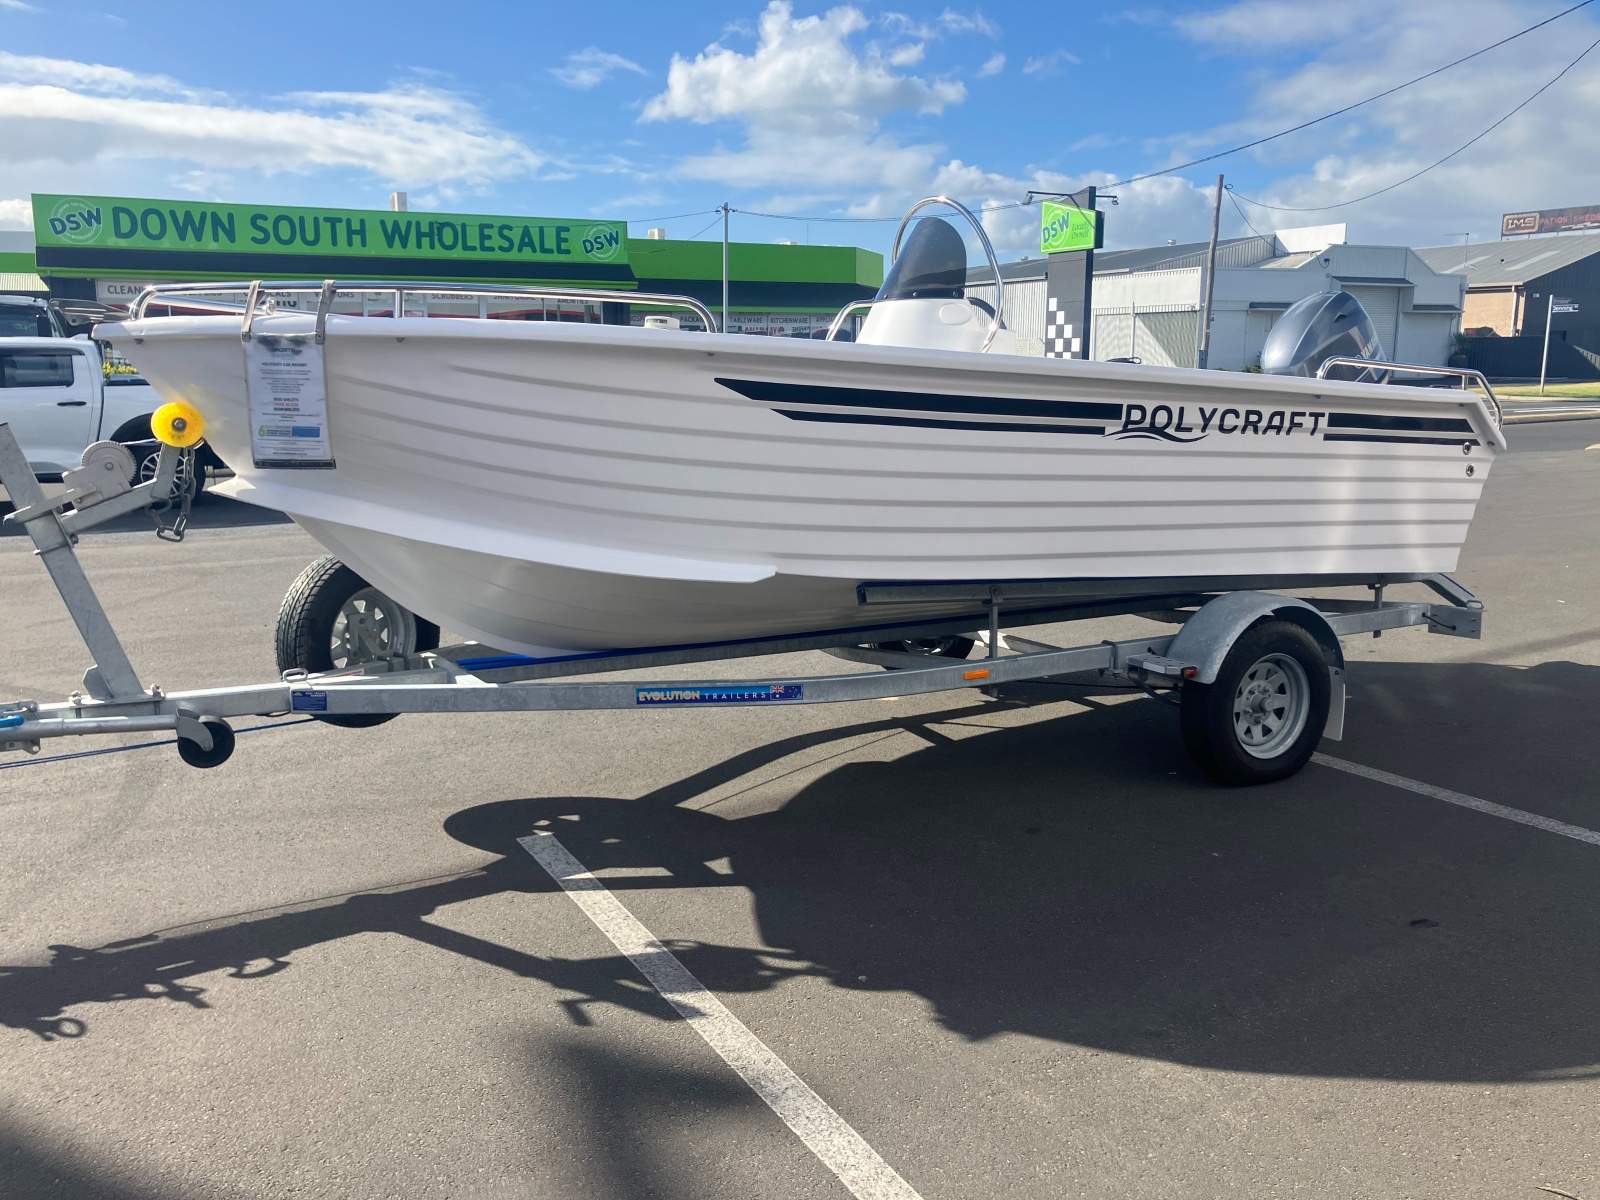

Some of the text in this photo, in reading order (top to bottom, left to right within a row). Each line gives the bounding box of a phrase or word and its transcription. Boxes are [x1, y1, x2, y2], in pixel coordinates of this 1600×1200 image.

[49, 207, 101, 235] DSW
[112, 206, 571, 255] DOWN SOUTH WHOLESALE
[1042, 212, 1070, 243] DSW
[582, 230, 619, 254] DSW
[1122, 404, 1327, 437] POLYCRAFT
[638, 690, 766, 702] EVOLUTION TRAILERS
